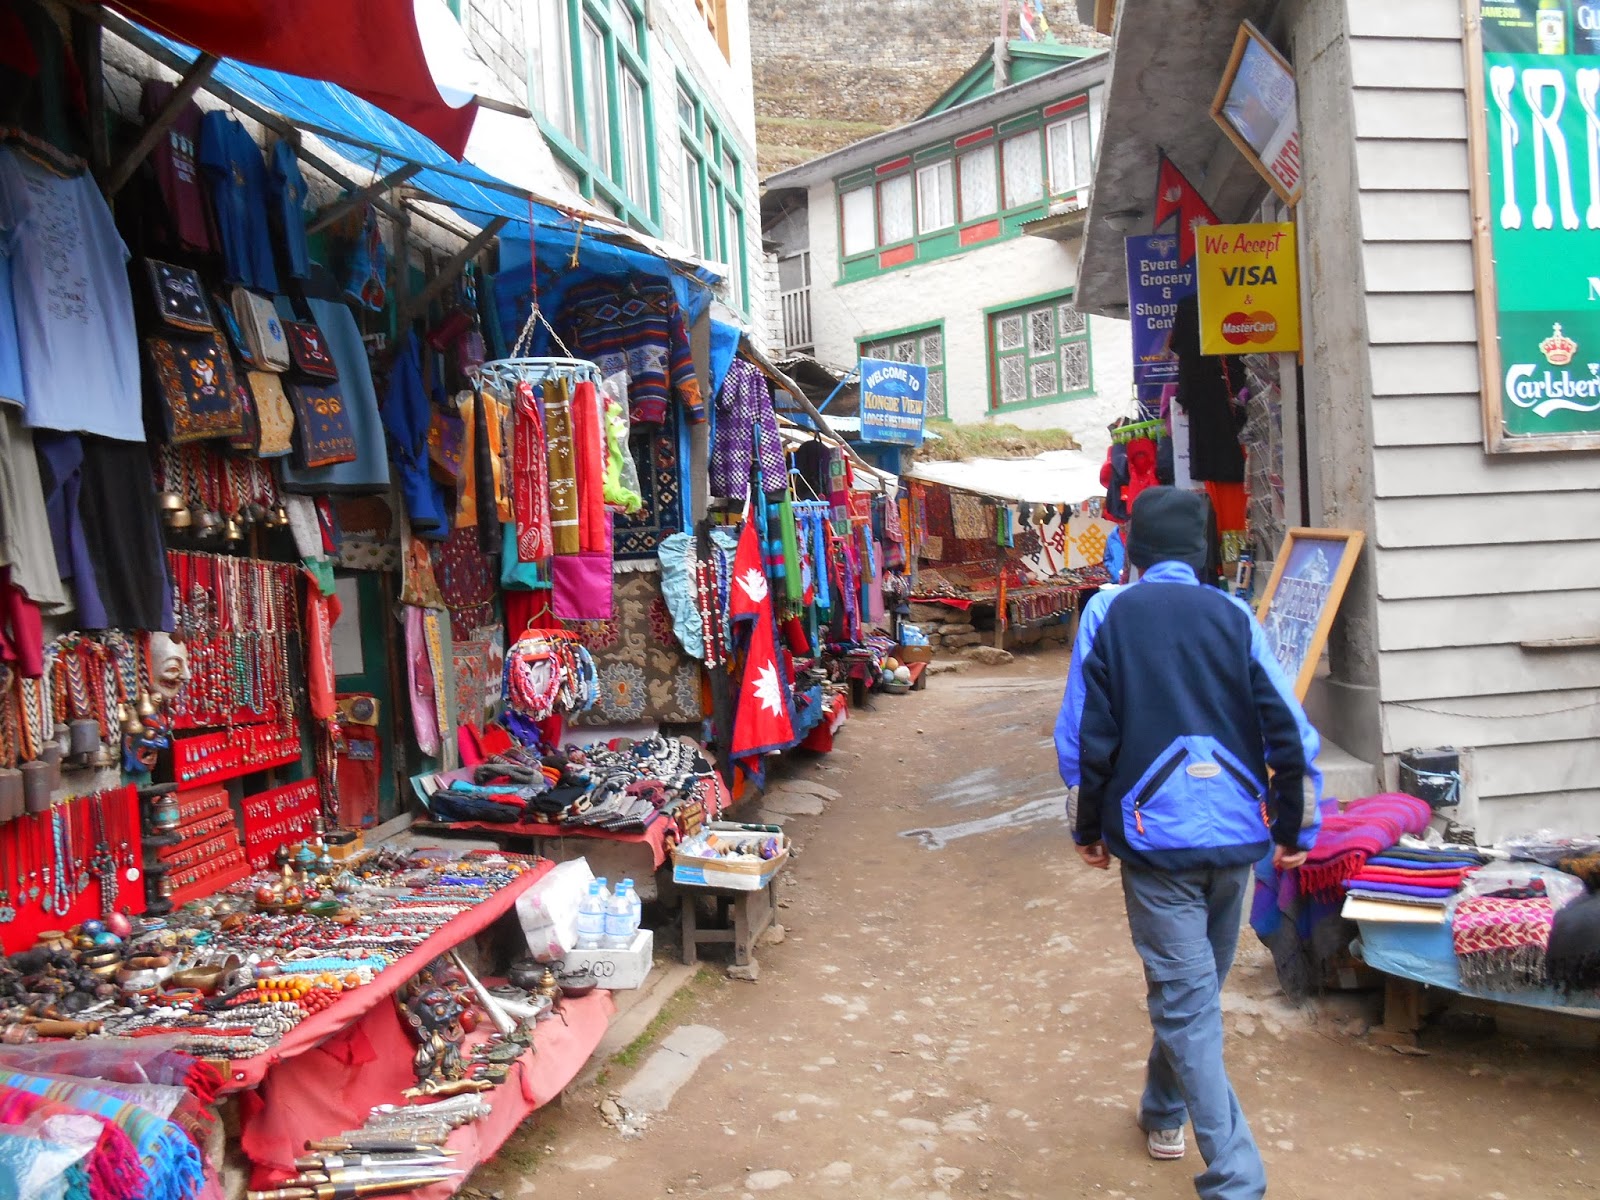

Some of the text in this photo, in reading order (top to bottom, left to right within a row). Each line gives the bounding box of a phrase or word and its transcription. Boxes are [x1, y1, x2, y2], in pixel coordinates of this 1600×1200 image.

[1270, 131, 1299, 189] ENTR
[1205, 232, 1287, 259] We Accept
[1140, 259, 1178, 272] Evere
[1140, 273, 1192, 287] Grocery
[1220, 266, 1277, 286] VISA
[1162, 286, 1172, 299] &
[1244, 294, 1254, 305] &
[1135, 303, 1178, 317] Shopp
[1147, 317, 1175, 330] Cen
[1222, 322, 1276, 334] MasterCard
[866, 366, 920, 391] WELCOME TO
[901, 396, 923, 414] VIEW
[863, 412, 884, 427] LODGE
